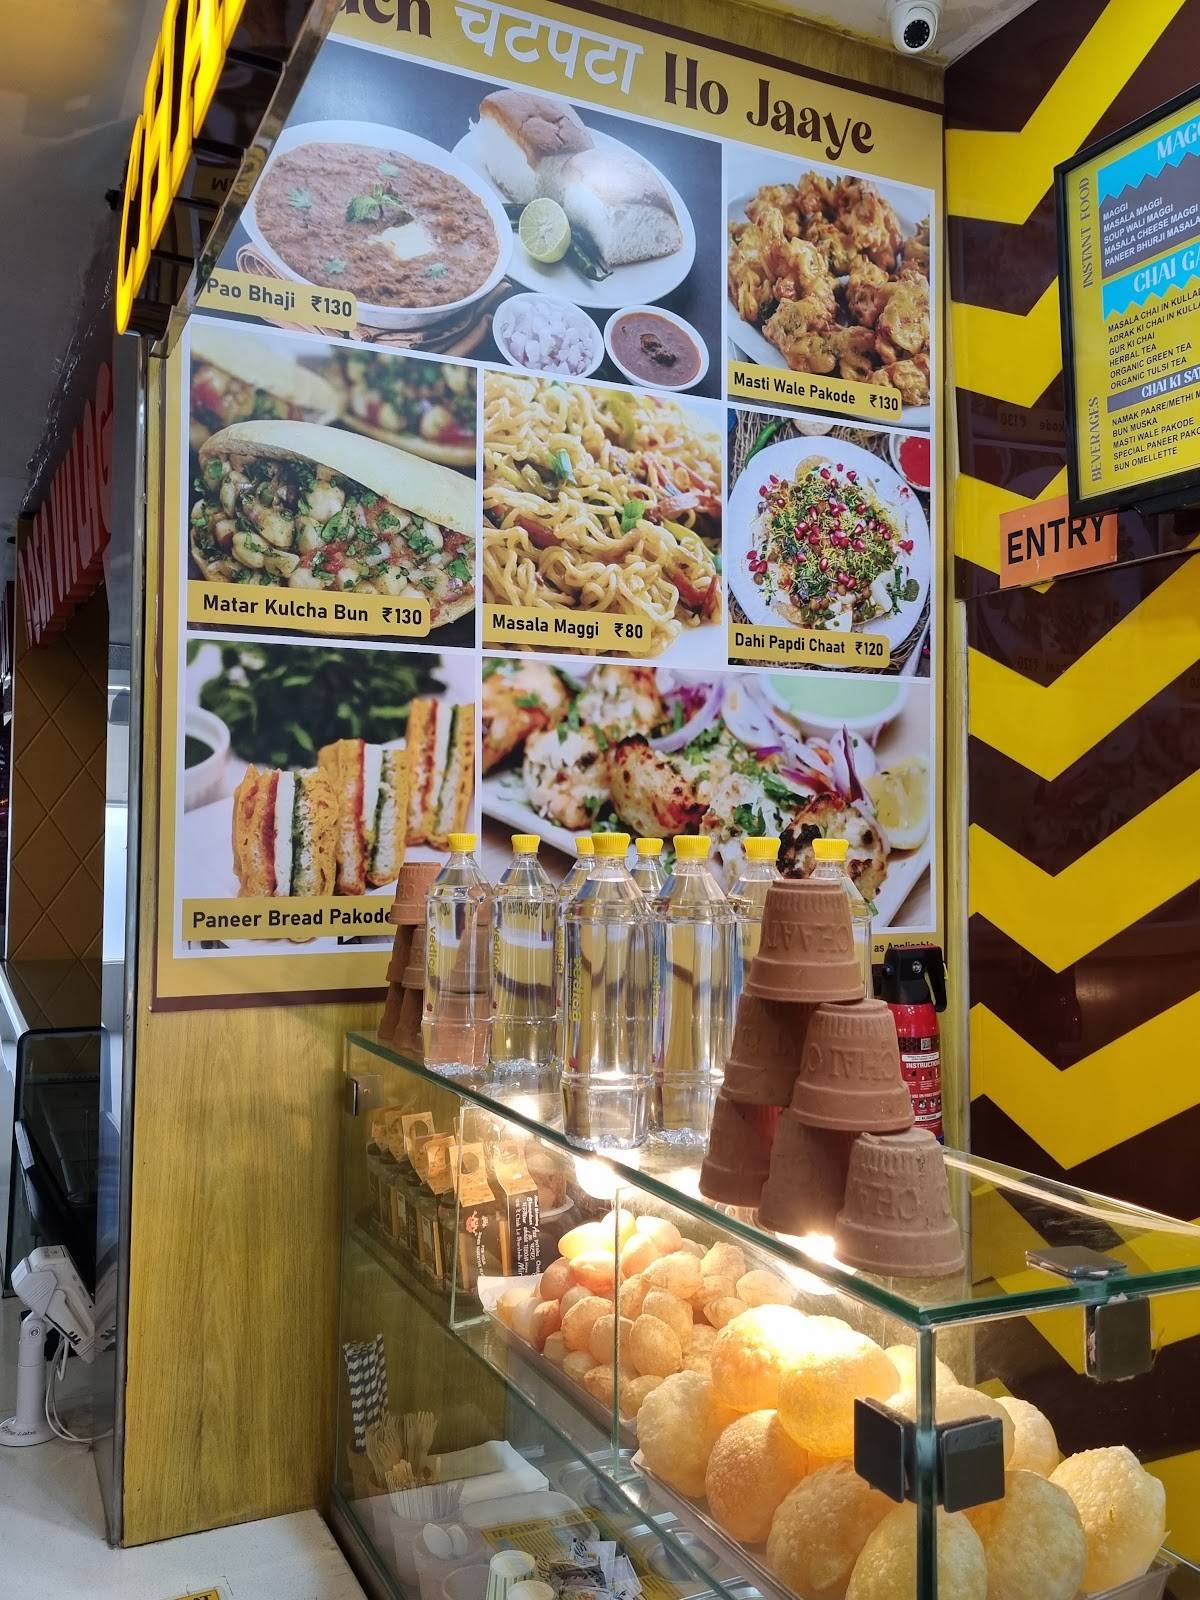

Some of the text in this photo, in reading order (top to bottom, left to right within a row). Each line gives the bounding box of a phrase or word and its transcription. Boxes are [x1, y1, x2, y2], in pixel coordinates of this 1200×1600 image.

[455, 2, 645, 95] चटपटा
[664, 51, 729, 116] Ho
[747, 78, 875, 160] Jaaye
[1157, 119, 1200, 161] MAG
[1103, 202, 1128, 221] MAGGI
[1103, 197, 1163, 232] MASALA MAGGI
[1104, 203, 1174, 244] SOUP WALI MAGGI
[1079, 177, 1094, 288] INSTANT FOOD
[1104, 203, 1199, 255] MASALA CHEESE MAGGI
[1105, 247, 1135, 267] PANEER
[1136, 232, 1165, 252] BHURJI
[1133, 257, 1177, 293] CHAI
[206, 277, 353, 318] Pao Bhaji ₹130
[1108, 315, 1139, 333] MASALA
[1140, 305, 1159, 320] CHAI
[1161, 301, 1169, 312] IN
[1109, 329, 1135, 344] ADRAK
[1136, 325, 1144, 333] KI
[1146, 315, 1165, 329] CHAI
[1166, 312, 1174, 321] IN
[1109, 331, 1155, 356] GUR KI CHAI
[1109, 343, 1157, 368] HERBAL TEA
[1110, 342, 1192, 379] ORGANIC GREEN TEA
[1110, 356, 1187, 390] ORGANIC TULSI TEA
[733, 371, 899, 411] Masti Wale Pakode ₹130
[1141, 378, 1167, 398] CHAI
[1169, 374, 1181, 389] KI
[1112, 410, 1139, 426] NAMAK
[1112, 417, 1158, 438] BUN MUSKA
[1113, 416, 1194, 449] MASTI WALE PAKODE
[1088, 396, 1102, 482] BEVERAGES
[1113, 444, 1145, 460] SPECIAL
[1147, 435, 1178, 450] PANEER
[1114, 446, 1178, 472] BUN OMELLETTE
[1007, 512, 1105, 565] ENTRY
[203, 592, 423, 626] Matar Kulcha Bun ₹130
[491, 613, 644, 640] Masala Maggi ₹80
[734, 632, 885, 658] Dahi Papdi Chaat ₹120
[192, 909, 263, 929] Paneer
[267, 908, 324, 927] Bread
[873, 944, 885, 953] as
